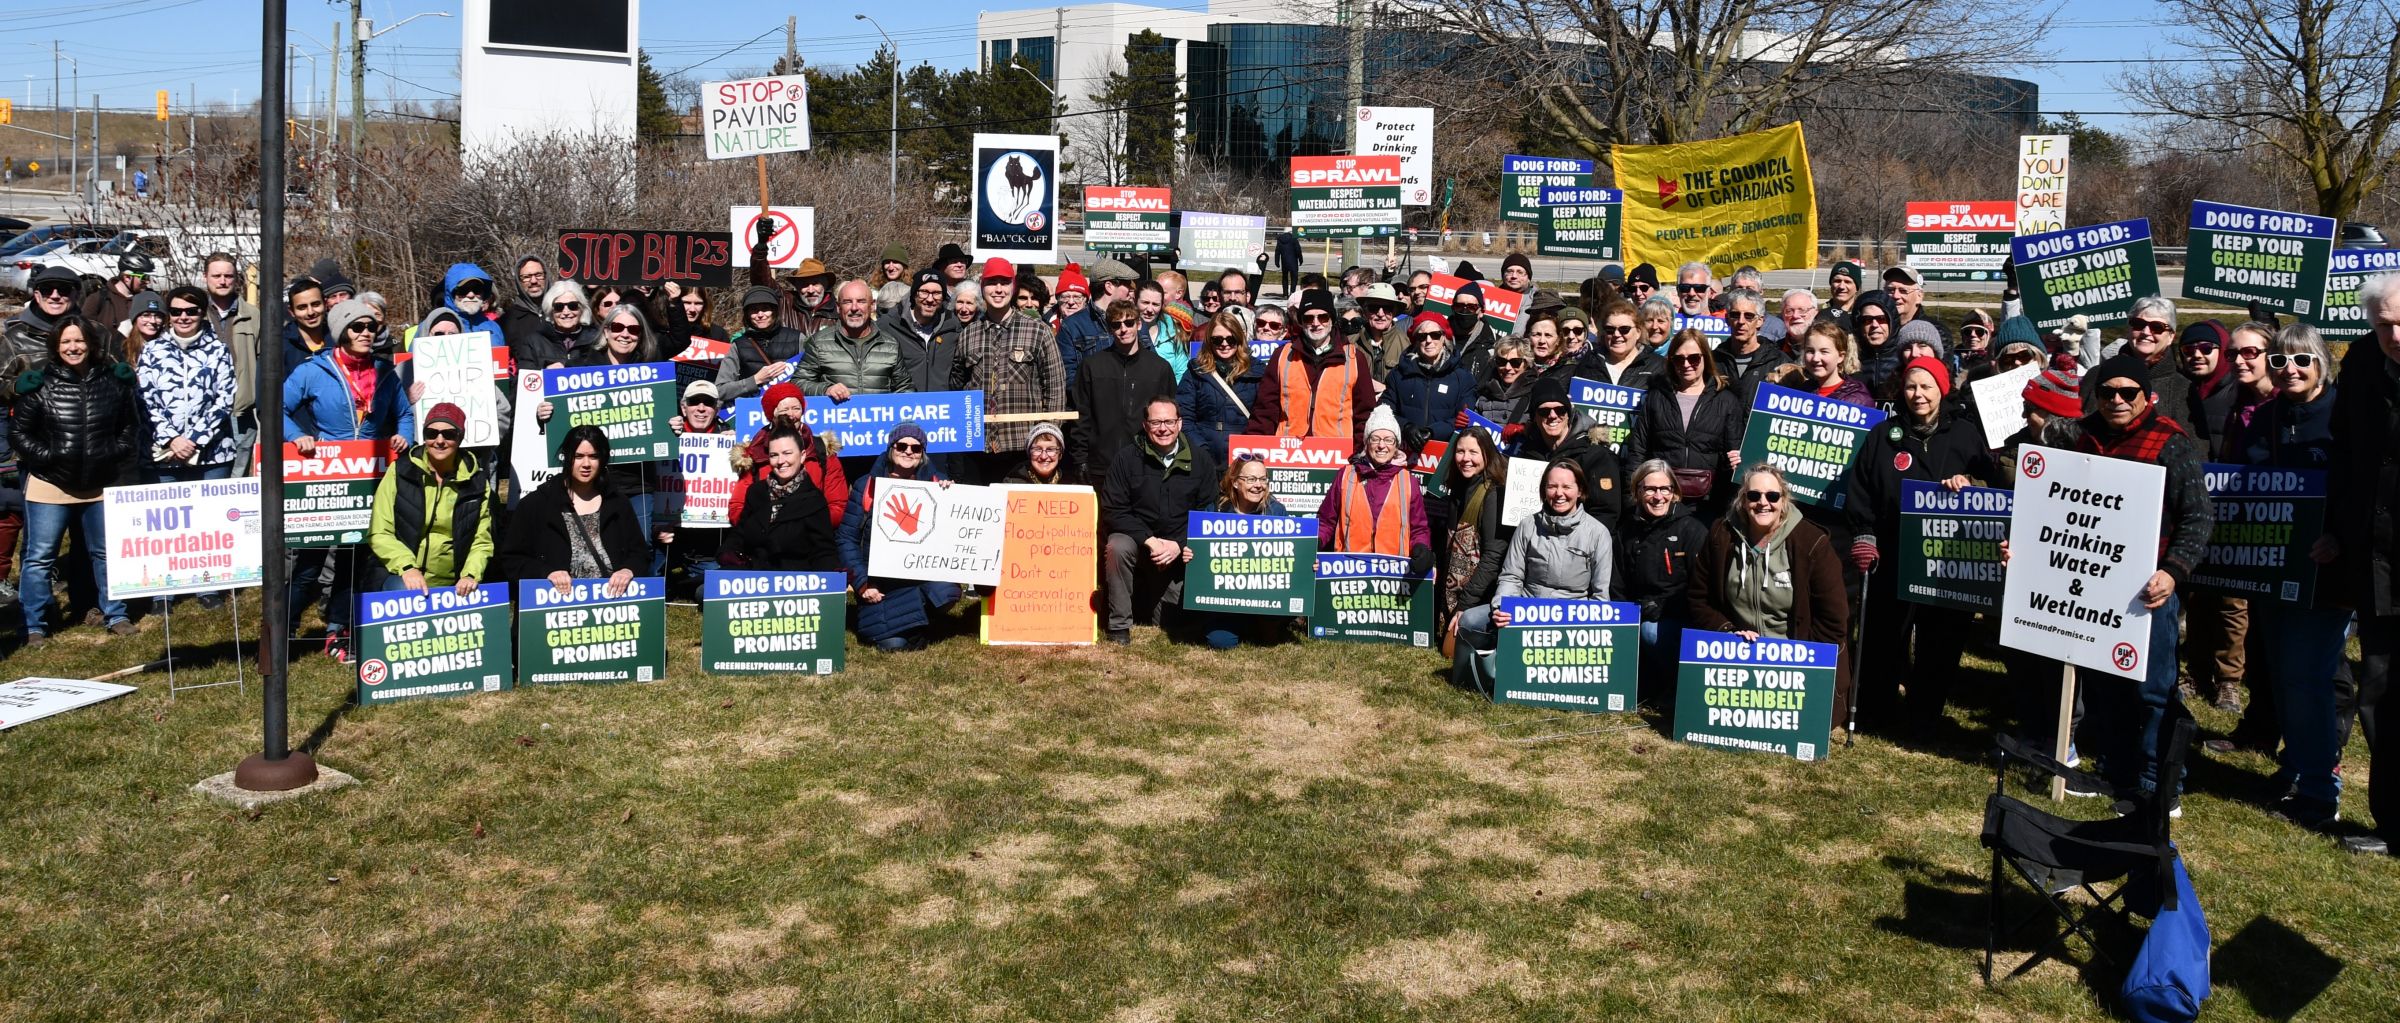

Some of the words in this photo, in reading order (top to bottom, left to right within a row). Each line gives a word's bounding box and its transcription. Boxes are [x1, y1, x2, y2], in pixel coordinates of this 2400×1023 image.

[720, 81, 783, 105] STOP
[713, 103, 796, 130] PAVING
[1376, 122, 1415, 130] Protect
[715, 126, 797, 153] NATURE
[2027, 139, 2053, 155] IF
[1373, 144, 1417, 154] Drinking
[1336, 160, 1356, 168] STOP
[1513, 161, 1544, 171] DOUG
[1548, 161, 1581, 171] FORD:
[1683, 172, 1714, 190] THE
[1719, 156, 1792, 183] COUNCIL
[2024, 158, 2064, 174] YOU
[1294, 169, 1399, 183] SPRAWL
[2022, 176, 2064, 190] DON'T
[1330, 189, 1363, 198] RESPECT
[1548, 192, 1576, 202] DOUG
[1580, 190, 1611, 201] FORD:
[1686, 192, 1706, 208] OF
[1710, 175, 1795, 205] CANADIANS
[2020, 192, 2063, 208] CARE
[1088, 198, 1168, 209] SPRAWL
[1298, 200, 1338, 209] WATERLOO
[1339, 199, 1374, 208] REGION'S
[1377, 198, 1396, 208] PLAN
[1553, 208, 1576, 218] KEEP
[1579, 207, 1606, 217] YOUR
[1950, 205, 1970, 213] STOP
[1553, 218, 1606, 229] GREENBELT
[1656, 228, 1700, 240] PEOPLE.
[1702, 224, 1739, 237] PLANET.
[1742, 213, 1805, 234] DEMOCRACY.
[1908, 215, 2014, 227] SPRAWL
[2206, 211, 2254, 230] DOUG
[2259, 215, 2313, 233] FORD:
[1028, 235, 1048, 243] OFF
[1556, 230, 1603, 241] PROMISE!
[1944, 234, 1977, 243] RESPECT
[2026, 236, 2074, 258] DOUG
[2077, 225, 2130, 247] FORD:
[1912, 244, 1952, 253] WATERLOO
[1953, 244, 1988, 253] REGION'S
[2212, 234, 2252, 251] KEEP
[2257, 238, 2304, 256] YOUR
[559, 233, 635, 279] STOP
[642, 234, 701, 279] BILL
[693, 238, 728, 266] 23
[1705, 247, 1768, 265] CANADIANS.ORG
[2039, 258, 2078, 279] KEEP
[2081, 248, 2129, 270] YOUR
[2211, 251, 2303, 272] GREENBELT
[2044, 265, 2131, 295] GREENBELT
[2215, 267, 2296, 288] PROMISE!
[2051, 282, 2132, 311] PROMISE!
[418, 336, 482, 368] SAVE
[429, 367, 483, 394] OUR
[557, 373, 604, 391] DOUG
[608, 365, 658, 385] FORD:
[568, 393, 606, 413] KEEP
[609, 388, 654, 407] YOUR
[1582, 386, 1628, 405] DOUG
[824, 406, 894, 425] HEALTH
[900, 404, 950, 420] CARE
[1768, 393, 1814, 416] DOUG
[1817, 402, 1867, 425] FORD:
[842, 431, 872, 446] Not
[965, 420, 973, 448] Ontario
[1769, 418, 1808, 438] KEEP
[1812, 425, 1854, 447] YOUR
[1767, 435, 1851, 464] GREENBELT
[201, 482, 259, 497] Housing
[306, 483, 349, 497] RESPECT
[2049, 481, 2123, 510] Protect
[318, 496, 363, 509] REGION'S
[1038, 501, 1079, 515] NEED
[1915, 491, 1959, 510] DOUG
[1964, 492, 2013, 511] FORD:
[133, 517, 141, 526] is
[146, 506, 193, 531] NOT
[951, 504, 1001, 523] HANDS
[2066, 511, 2101, 529] our
[959, 527, 983, 539] OFF
[1202, 520, 1248, 535] DOUG
[1254, 519, 1301, 534] FORD:
[1922, 518, 1958, 537] KEEP
[1962, 520, 2006, 539] YOUR
[121, 530, 234, 558] Affordable
[304, 535, 334, 543] gren.ca
[2039, 526, 2125, 563] Drinking
[955, 544, 977, 554] THE
[1030, 544, 1092, 559] protection
[1210, 542, 1248, 557] KEEP
[1251, 542, 1294, 556] YOUR
[169, 554, 231, 571] Housing
[904, 549, 1000, 571] GREENBELT!
[1210, 558, 1294, 573] GREENBELT
[1322, 560, 1366, 575] DOUG
[2049, 550, 2111, 578] Water
[1011, 563, 1040, 579] Don't
[1049, 569, 1072, 579] cut
[1926, 559, 2001, 582] PROMISE!
[719, 577, 769, 596] DOUG
[774, 574, 827, 592] FORD:
[1214, 573, 1290, 589] PROMISE!
[1330, 581, 1367, 595] KEEP
[2069, 579, 2084, 596] &
[1004, 588, 1084, 600] conservation
[1196, 596, 1281, 608] GREENBELTPROMISE.CA
[371, 595, 427, 619] DOUG
[728, 602, 769, 619] KEEP
[773, 598, 820, 617] YOUR
[1010, 601, 1087, 613] authorities
[1515, 605, 1563, 622] DOUG
[1568, 604, 1620, 621] FORD:
[2029, 591, 2123, 628] Wetlands
[545, 609, 588, 629] KEEP
[592, 605, 640, 624] YOUR
[729, 615, 821, 637] GREENBELT
[1337, 610, 1409, 625] PROMISE!
[383, 621, 428, 643] KEEP
[432, 613, 484, 635] YOUR
[547, 622, 641, 647] GREENBELT
[2014, 616, 2095, 643] GreenlandPromise.ca
[385, 631, 485, 661] GREENBELT
[734, 633, 817, 654] PROMISE!
[1522, 631, 1562, 647] KEEP
[1566, 630, 1613, 646] YOUR
[552, 640, 637, 665] PROMISE!
[1522, 648, 1613, 665] GREENBELT
[1697, 641, 1750, 660] DOUG
[1756, 643, 1815, 663] FORD:
[392, 649, 483, 680] PROMISE!
[714, 661, 808, 671] GREENBELTPROMISE.CA
[532, 671, 628, 682] GREENBELTPROMISE.CA
[1527, 666, 1608, 683] PROMISE!
[1704, 668, 1749, 687] KEEP
[1753, 670, 1805, 690] YOUR
[372, 681, 474, 699] GREENBELTPROMISE.CA
[1506, 691, 1599, 705] GREENBELTPROMISE.CA
[1704, 688, 1805, 710] GREENBELT
[1709, 708, 1799, 730] PROMISE!
[1687, 732, 1786, 754] GREENBELTPROMISE.CA
